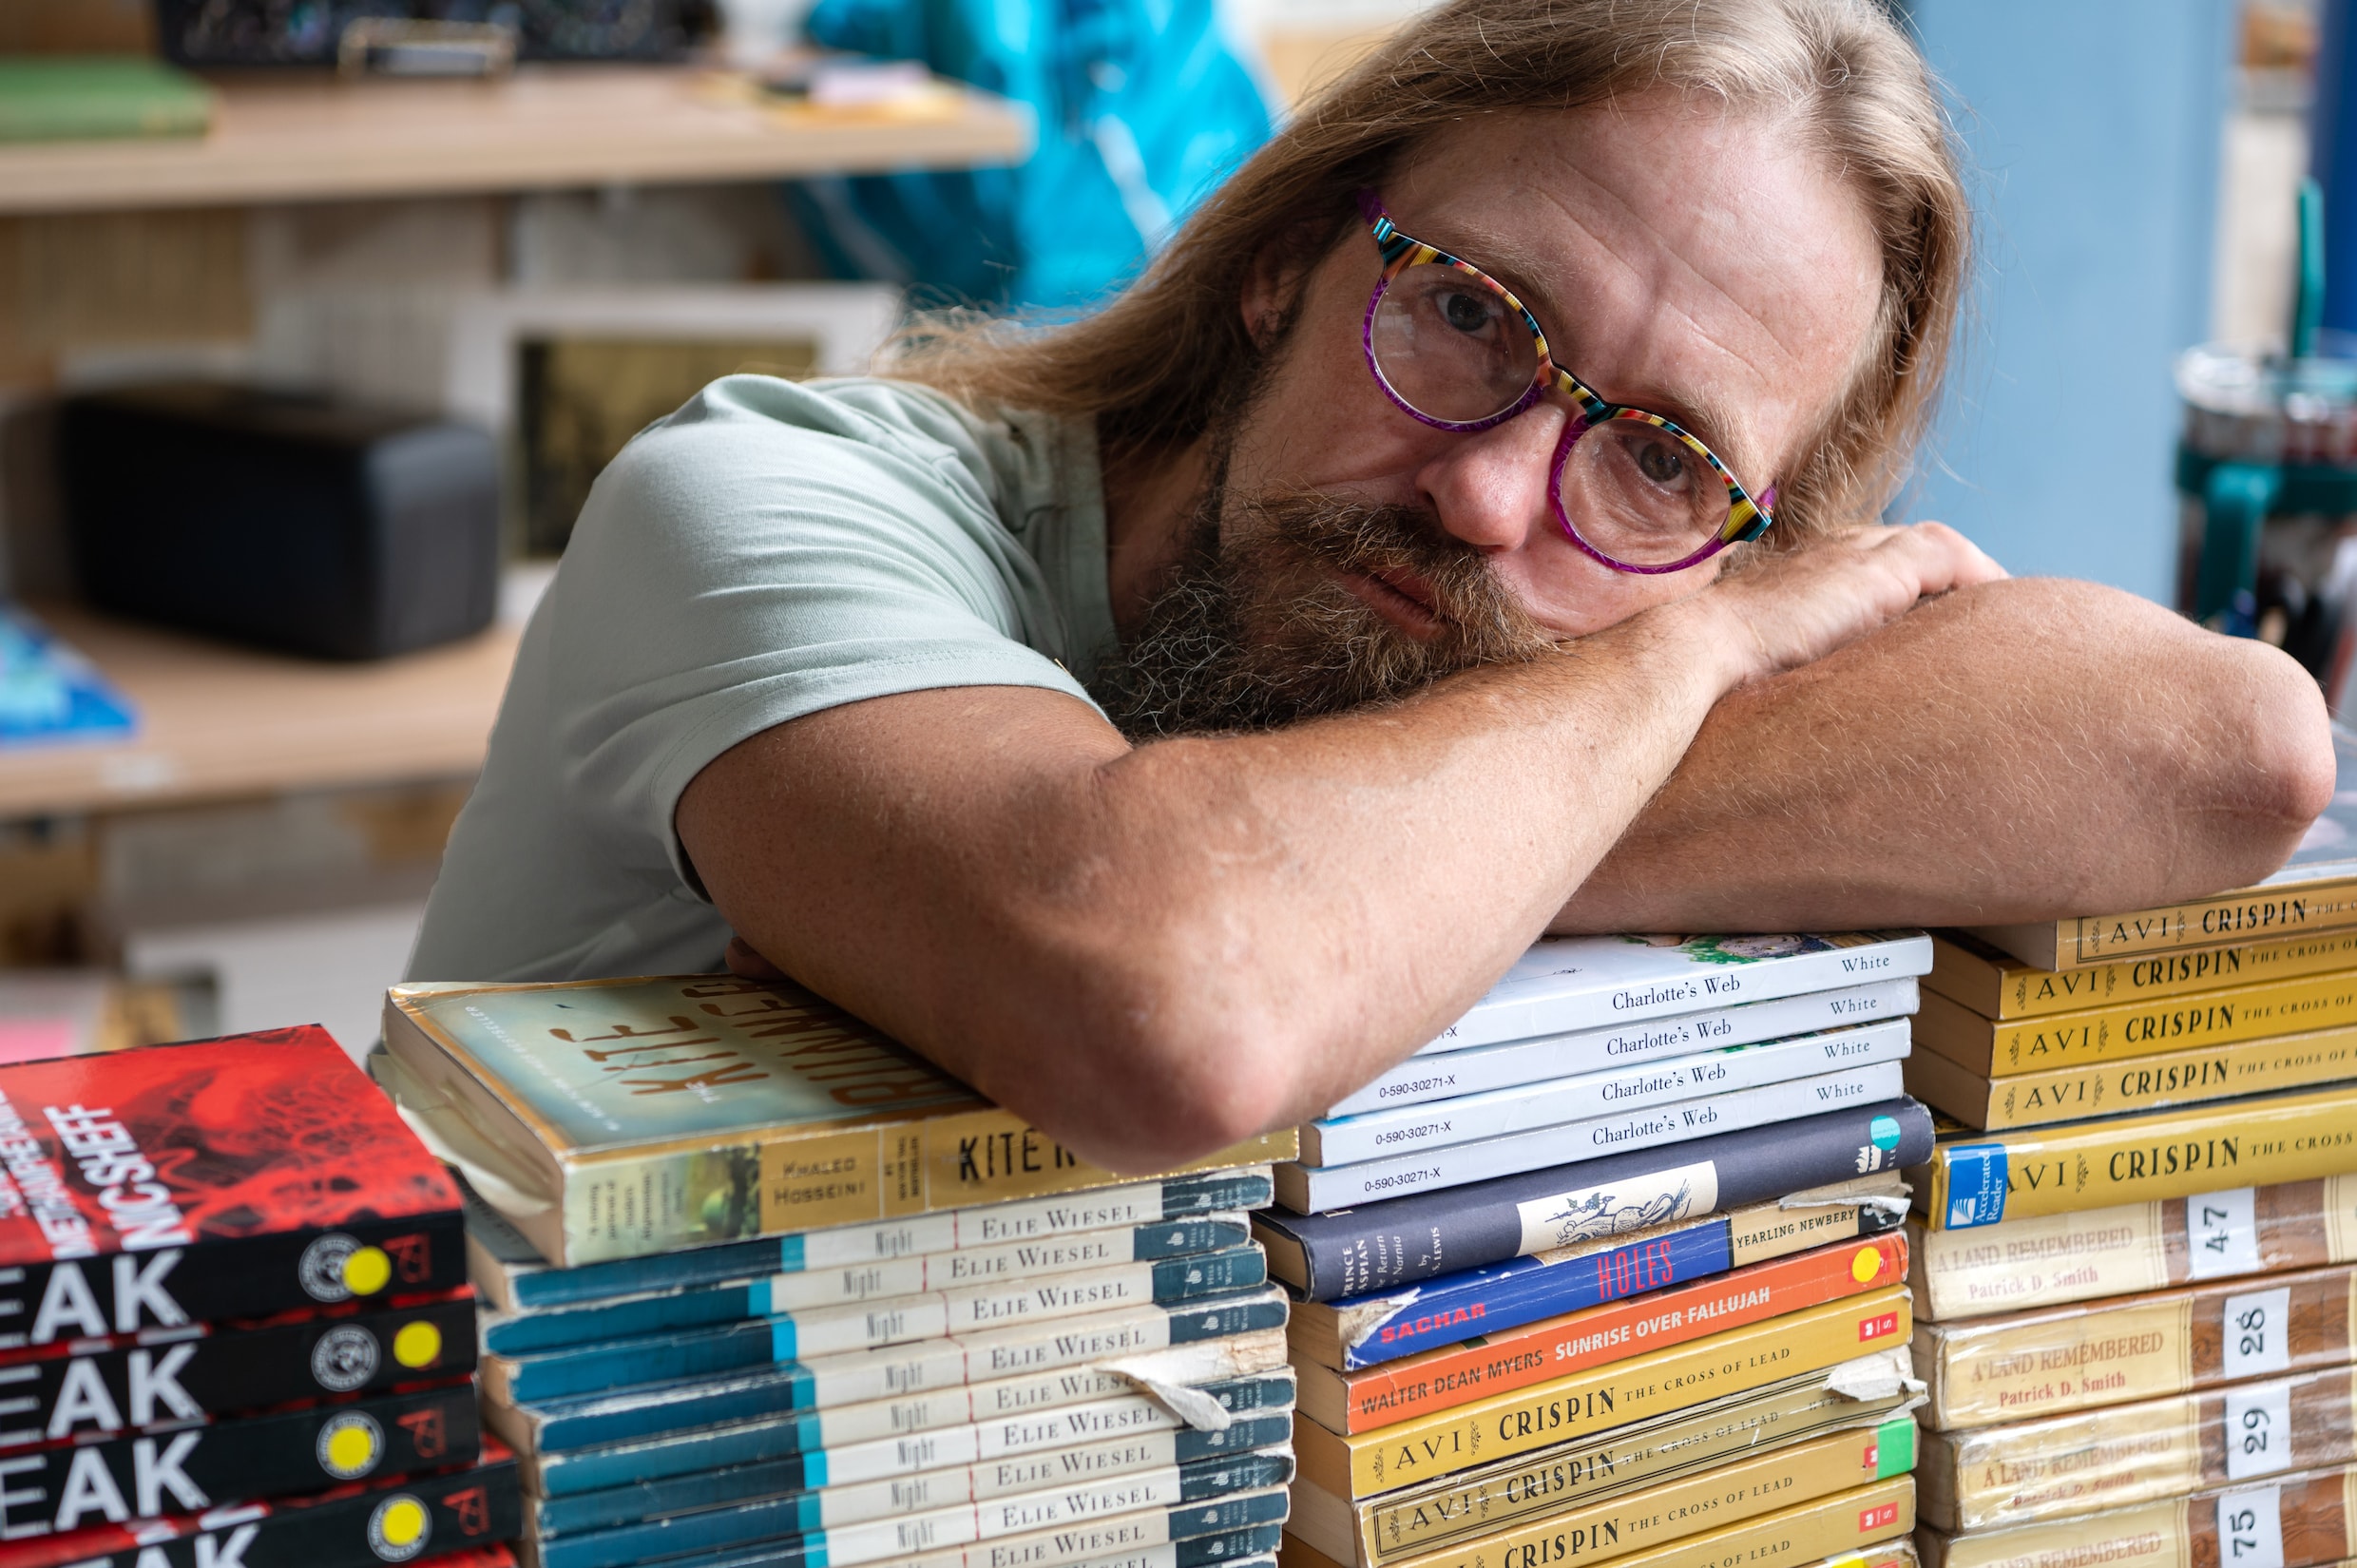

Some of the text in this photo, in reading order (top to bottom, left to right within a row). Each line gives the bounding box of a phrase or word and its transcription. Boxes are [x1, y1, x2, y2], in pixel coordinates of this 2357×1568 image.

[2109, 916, 2169, 945] AVI
[2202, 898, 2308, 934] CRISPIN
[1842, 956, 1890, 973] White
[2036, 970, 2097, 1000] AVI
[2133, 947, 2242, 988] CRISPIN
[2250, 951, 2281, 965] THE
[2343, 938, 2357, 951] O
[1613, 975, 1740, 1010] Charlotte's Web
[1830, 998, 1877, 1015] White
[1607, 1019, 1732, 1056] Charlotte's Web
[2028, 1026, 2090, 1056] AVI
[2125, 1004, 2235, 1042] CRISPIN
[2243, 1004, 2273, 1021] THE
[2280, 998, 2328, 1014] CROSS
[548, 1016, 770, 1096] KITE
[1824, 1042, 1870, 1059] White
[1379, 1074, 1456, 1099] 0-590-30271-X
[1602, 1063, 1726, 1101] Charlotte's Web
[1816, 1083, 1864, 1100] White
[2024, 1080, 2085, 1109] AVI
[2120, 1059, 2230, 1097] CRISPIN
[2237, 1060, 2268, 1075] THE
[2273, 1054, 2322, 1069] CROSS
[1375, 1120, 1452, 1145] 0-590-30271-X
[1593, 1107, 1717, 1145] Charlotte's Web
[959, 1128, 1042, 1182] KITE
[2109, 1137, 2241, 1183] CRISPIN
[2251, 1141, 2286, 1157] THE
[2295, 1131, 2353, 1150] CROSS
[1364, 1167, 1441, 1192] 0-590-30271-X
[1975, 1150, 1991, 1223] Accelerated
[1986, 1177, 2002, 1222] Reader
[875, 1230, 912, 1258] Night
[1430, 1227, 1442, 1261] LEWIS
[1736, 1209, 1856, 1249] YEARLING NEWBERY
[2203, 1205, 2229, 1253] 47
[1355, 1238, 1369, 1292] ASPIAN
[1376, 1235, 1387, 1274] Return
[1393, 1235, 1403, 1275] Narnia
[1418, 1254, 1430, 1267] by
[1937, 1227, 2134, 1272] A LAND REMEMBERED
[843, 1269, 881, 1299] Night
[1598, 1240, 1674, 1300] HOLES
[1968, 1276, 2024, 1300] Patrick
[2054, 1266, 2099, 1289] Smith
[866, 1312, 904, 1343] Night
[1381, 1303, 1486, 1344] SACHAR
[1555, 1287, 1771, 1361] SUNRISE OVER FALLUJAH
[2237, 1307, 2265, 1356] 28
[1971, 1331, 2164, 1383] A LAND REMEMBERED
[885, 1363, 922, 1394] Night
[1060, 1376, 1135, 1397] WIESE
[1361, 1349, 1543, 1415] WALTER DEAN MYERS
[2000, 1371, 2126, 1406] Patrick D. Smith
[891, 1403, 928, 1433] Night
[1394, 1348, 1791, 1470] AVI CRISPIN THE CROSS OF LEAD
[2243, 1407, 2271, 1455] 29
[897, 1440, 935, 1470] Night
[1409, 1411, 1780, 1530] AVI CRISPIN THE CROSS OF LEAD
[1983, 1468, 1994, 1488] A
[2000, 1459, 2046, 1484] LAND
[891, 1480, 928, 1510] Night
[2091, 1472, 2136, 1491] Smith
[897, 1521, 934, 1552] Night
[1504, 1477, 1794, 1568] CRISPIN THE CROSS OF LEAD
[2229, 1508, 2257, 1558] 75
[1724, 1539, 1792, 1568] OF LEAD
